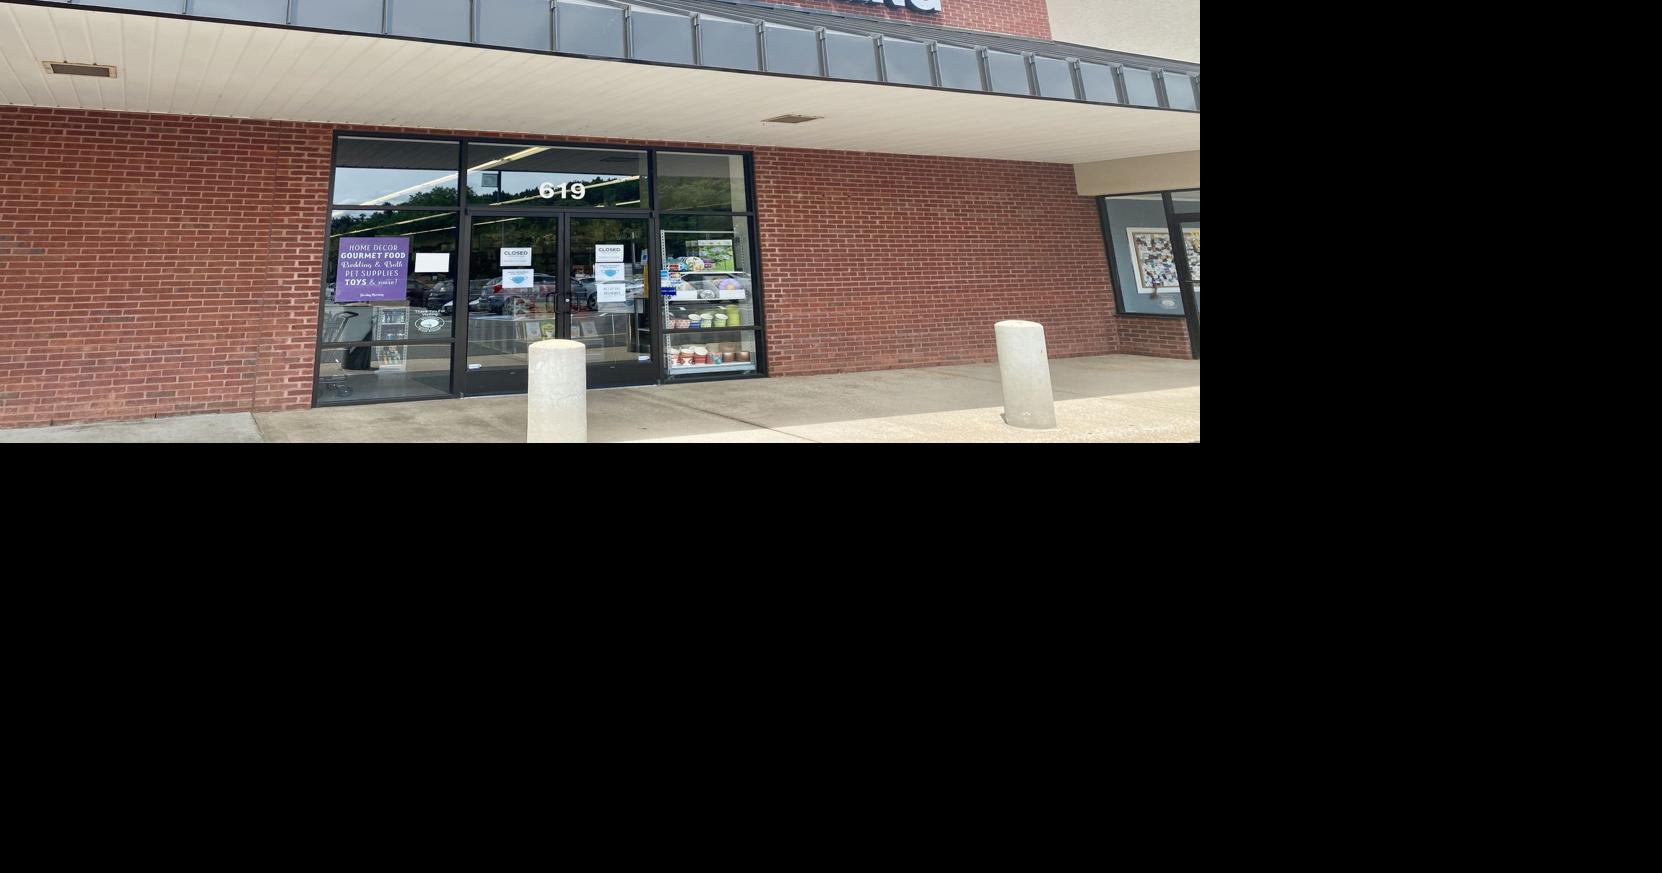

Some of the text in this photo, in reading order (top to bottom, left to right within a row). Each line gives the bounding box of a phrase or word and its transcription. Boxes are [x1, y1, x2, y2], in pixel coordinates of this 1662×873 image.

[539, 182, 586, 200] 619
[341, 261, 372, 269] Bedding
[345, 278, 367, 286] TOYS
